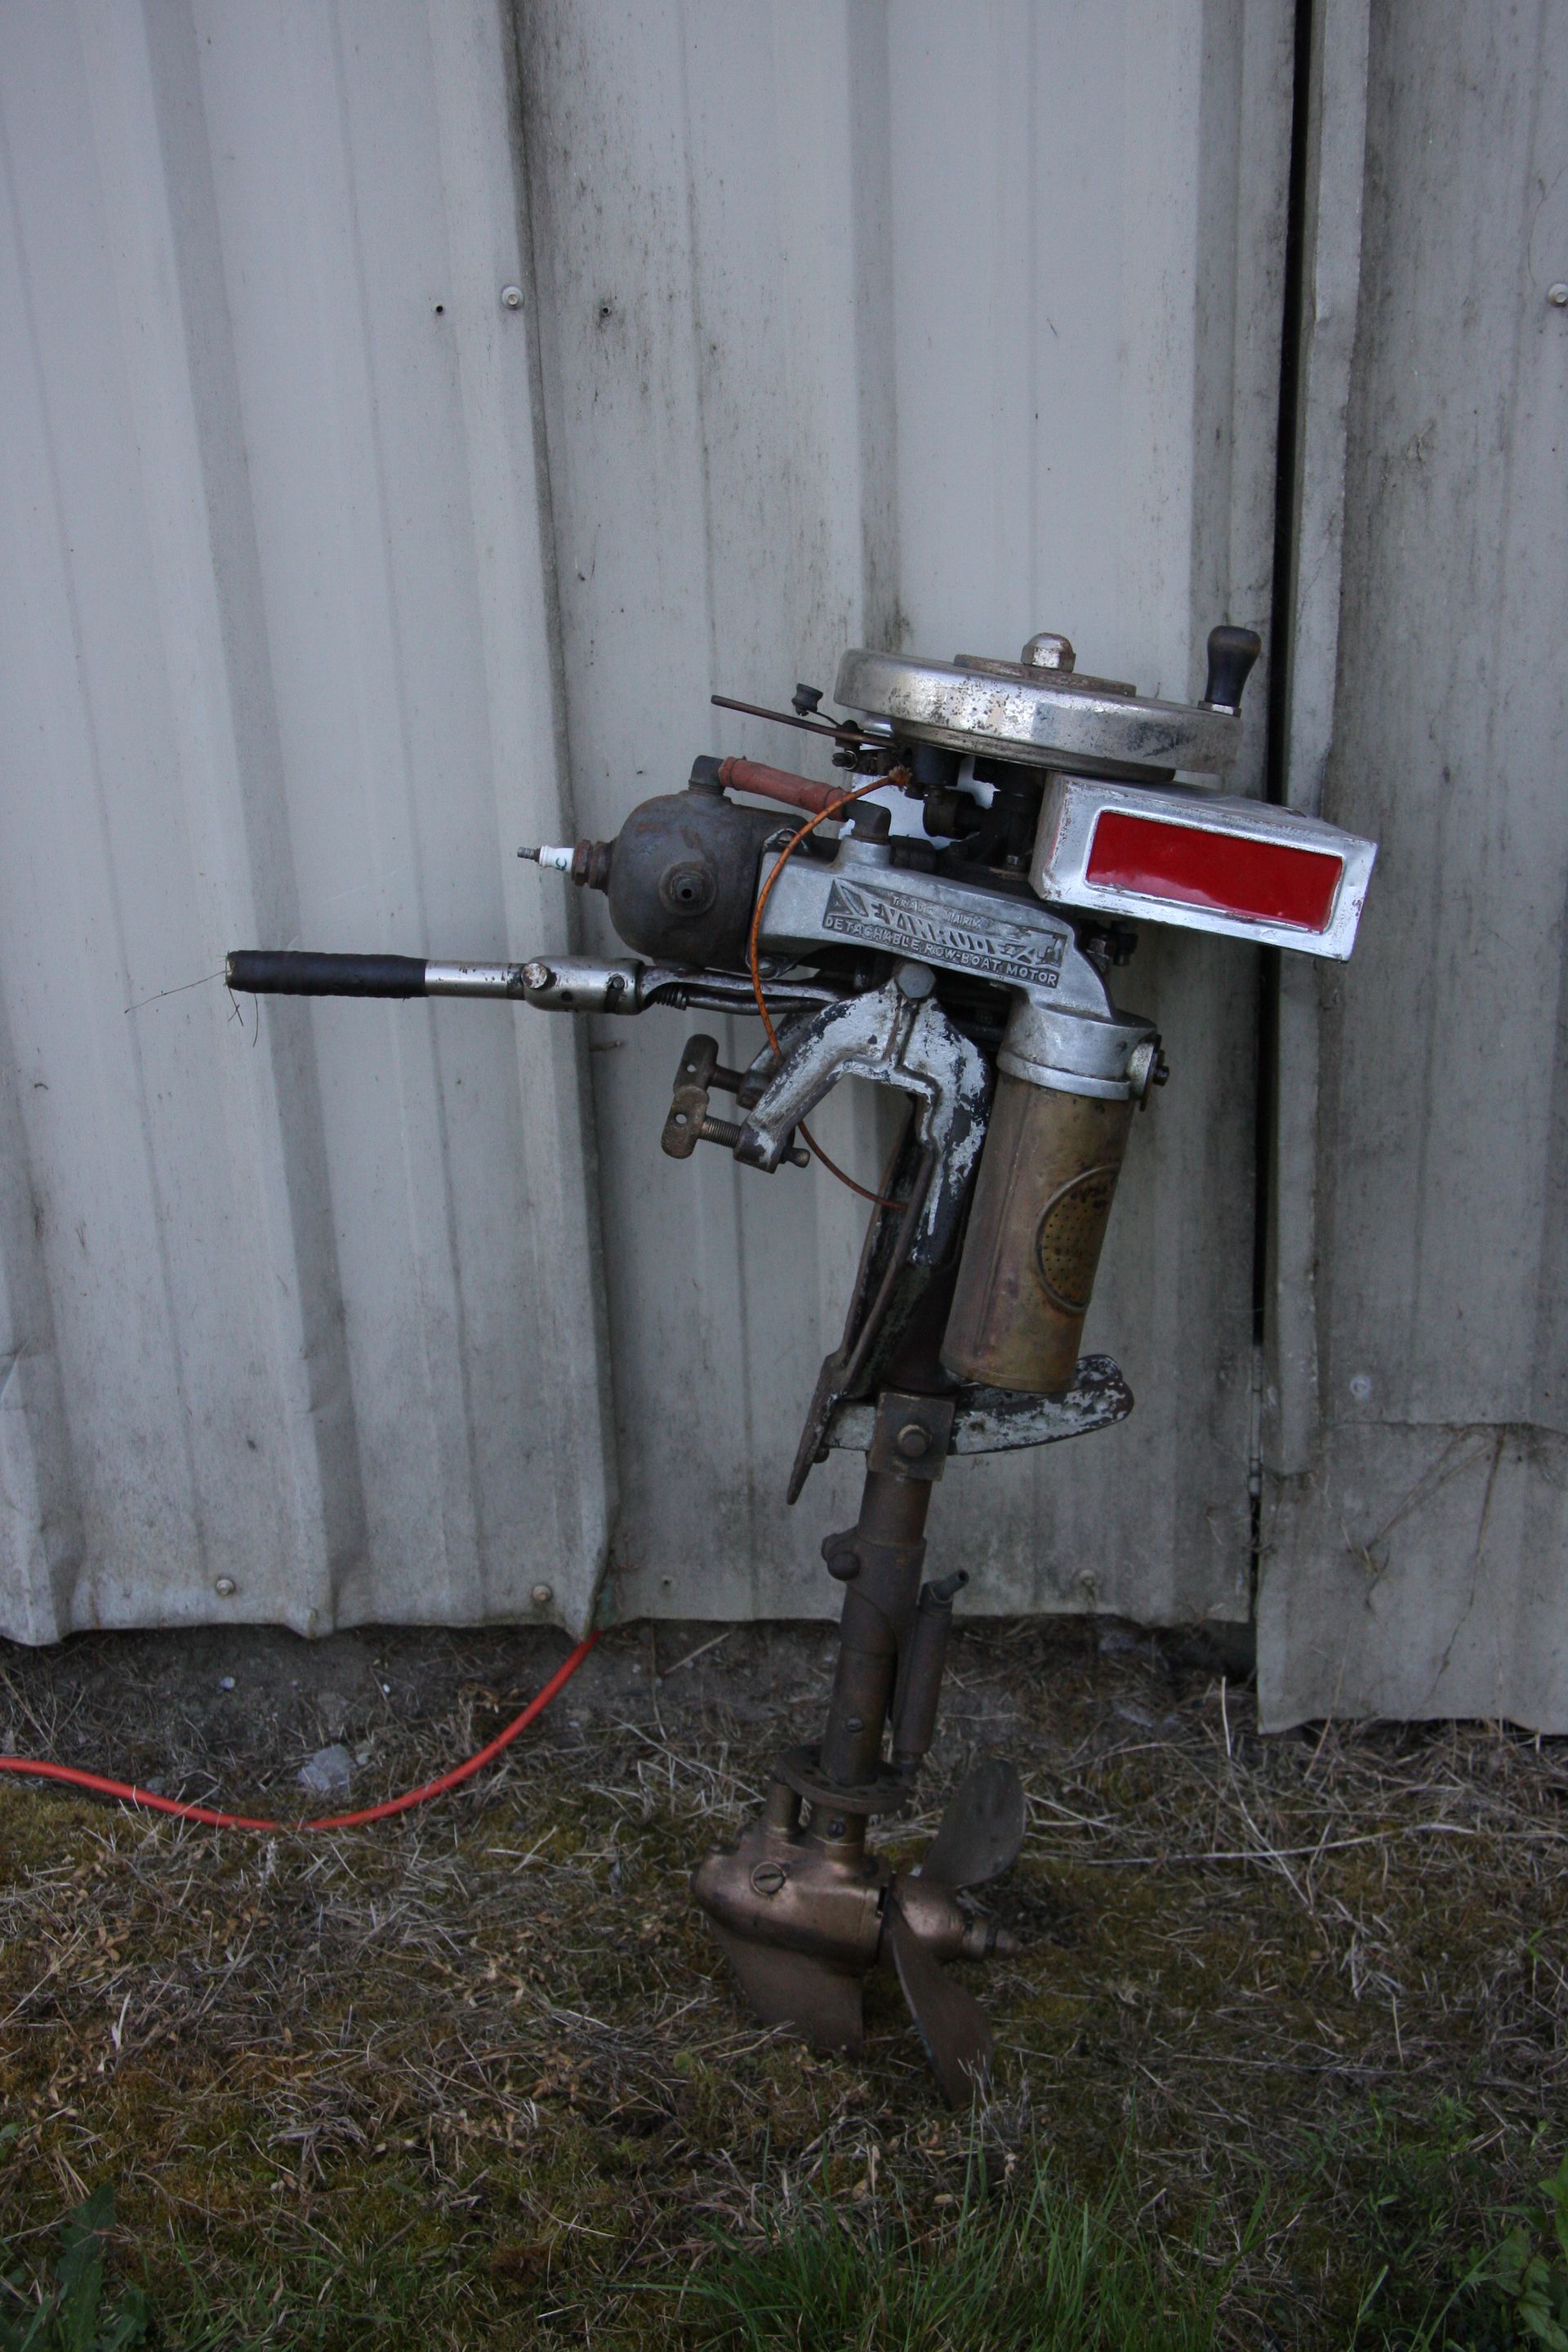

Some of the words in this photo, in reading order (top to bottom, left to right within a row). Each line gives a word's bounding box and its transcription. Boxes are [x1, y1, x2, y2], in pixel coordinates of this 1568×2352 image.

[865, 899, 1010, 958] EVINRUDE
[892, 896, 933, 916] TRADE
[943, 911, 982, 929] MARK
[825, 915, 920, 951] DETACHABLE
[924, 943, 1001, 972] ROW-BOAT
[1005, 964, 1058, 987] MOTOR
